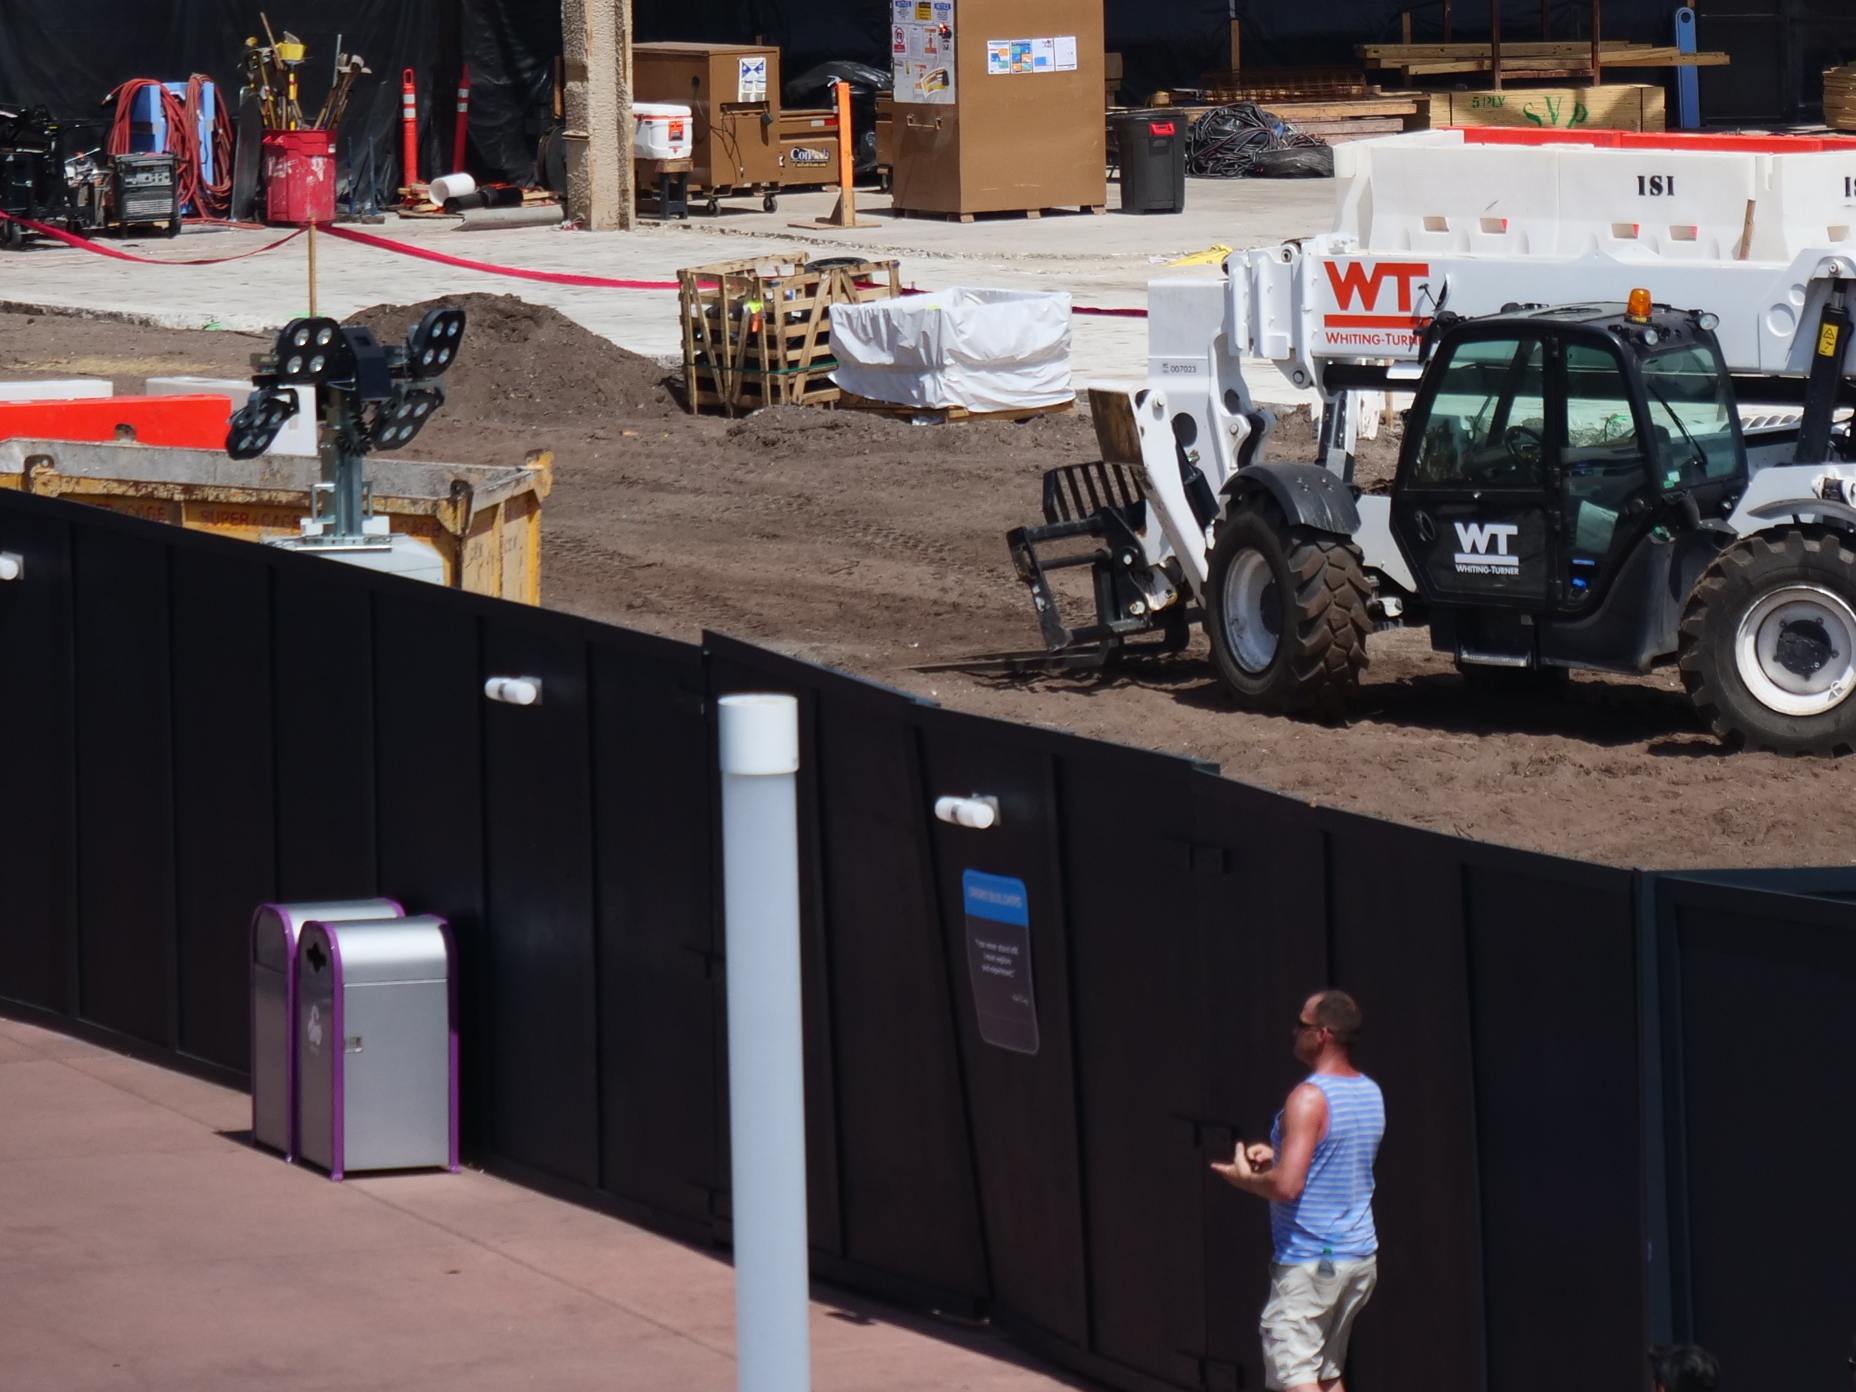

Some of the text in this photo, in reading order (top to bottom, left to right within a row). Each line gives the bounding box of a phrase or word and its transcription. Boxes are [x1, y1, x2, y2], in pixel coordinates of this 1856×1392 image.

[1483, 95, 1506, 108] PLY
[1637, 175, 1675, 196] ISI
[1323, 261, 1430, 312] WT
[1325, 331, 1423, 346] WHITING-TURN
[1454, 522, 1518, 555] WT
